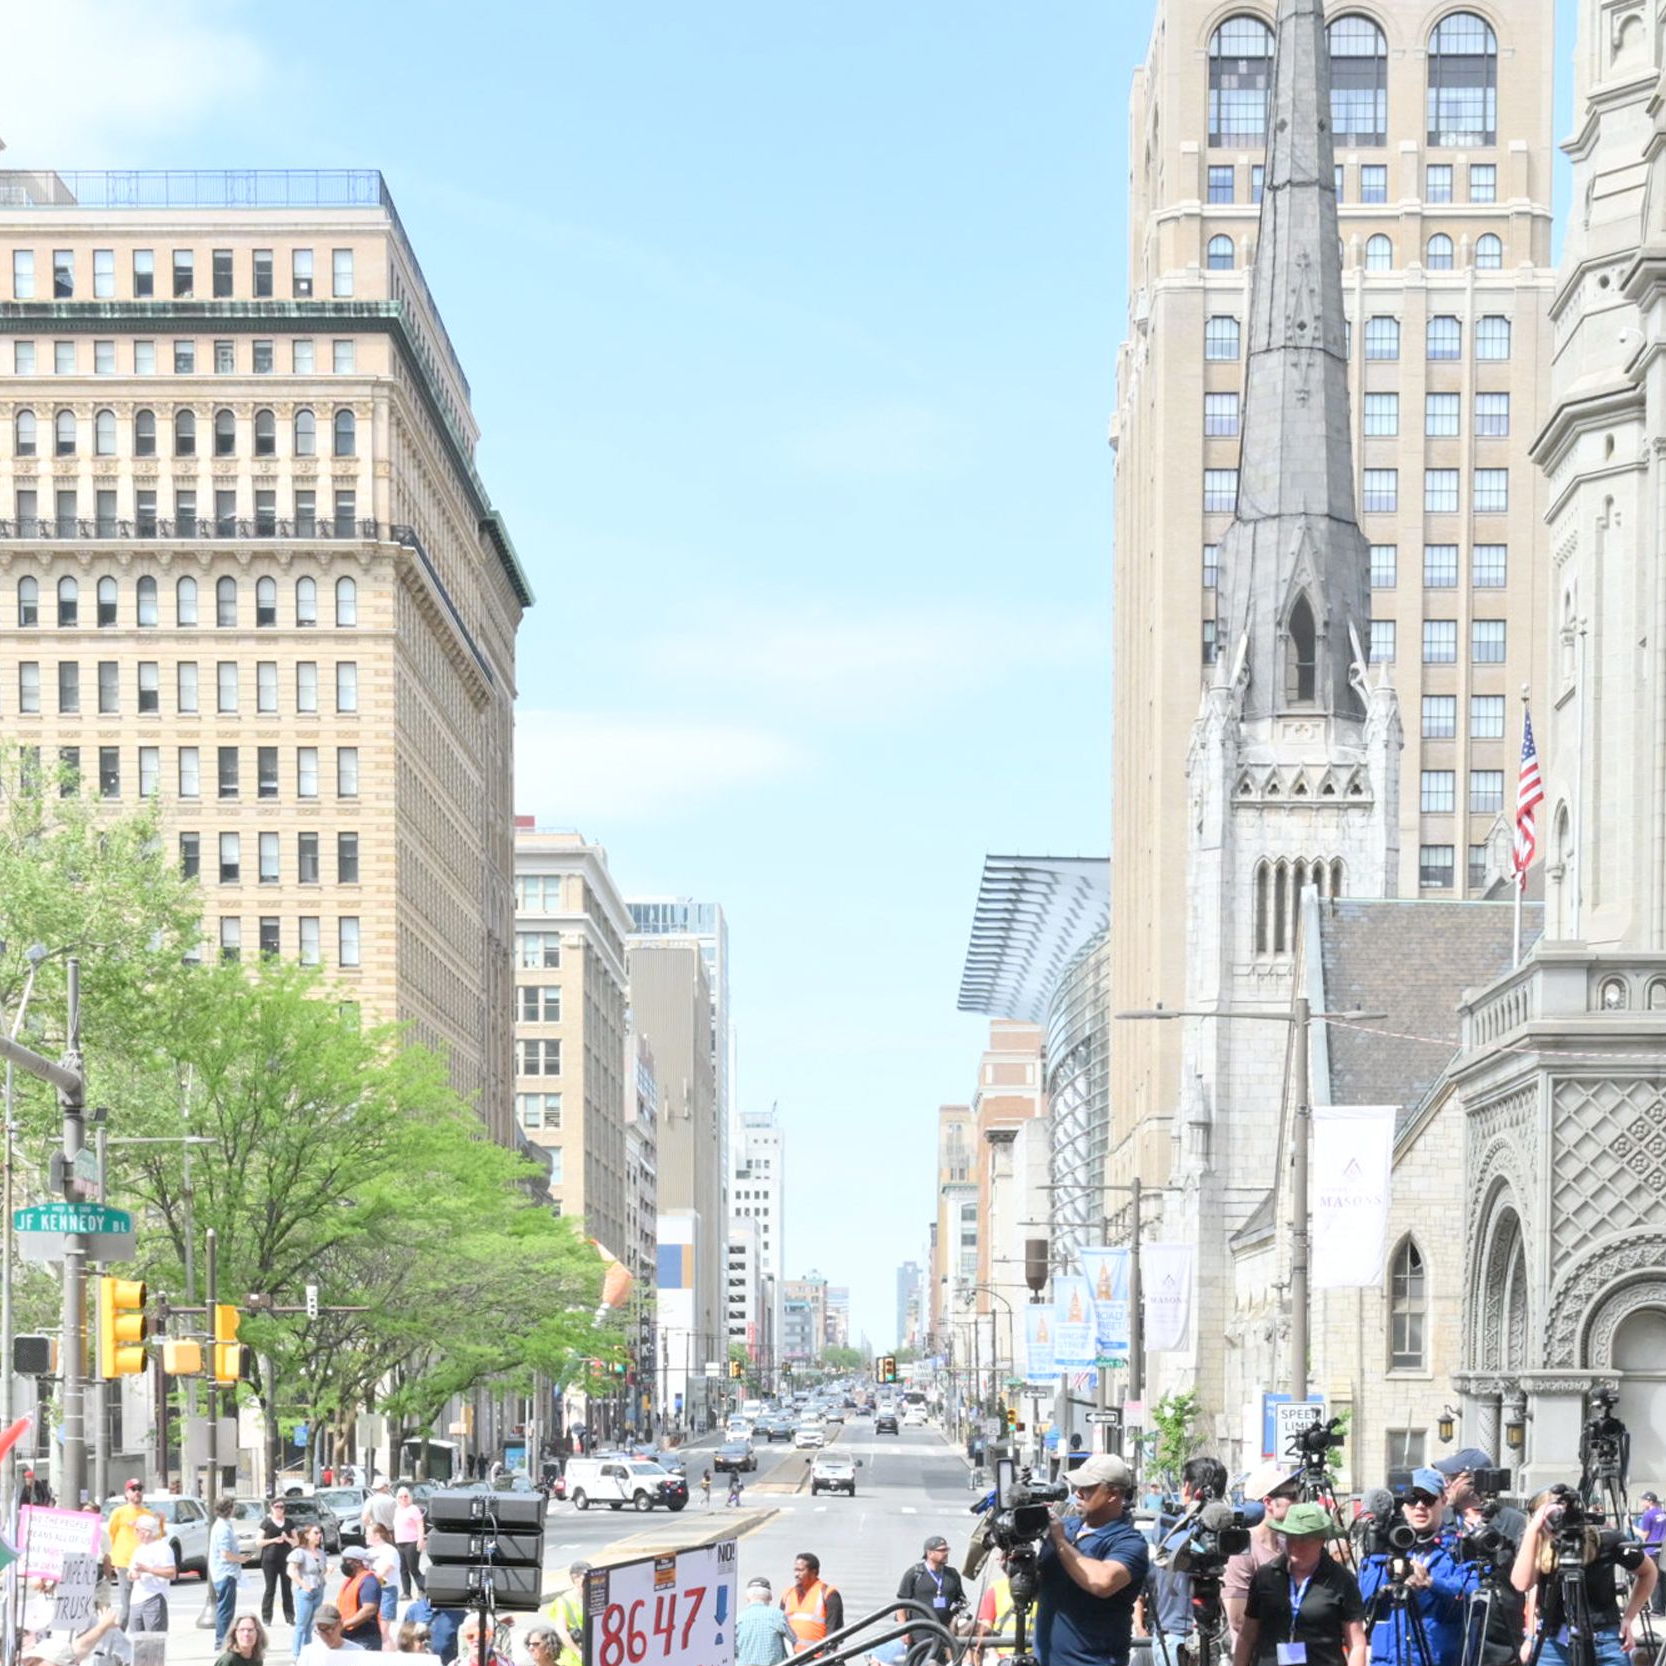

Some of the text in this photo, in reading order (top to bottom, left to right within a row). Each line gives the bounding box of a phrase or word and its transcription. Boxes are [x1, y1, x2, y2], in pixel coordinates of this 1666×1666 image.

[17, 1214, 33, 1230] JF
[41, 1215, 104, 1231] KENNEDY
[1284, 1422, 1313, 1432] LIMI
